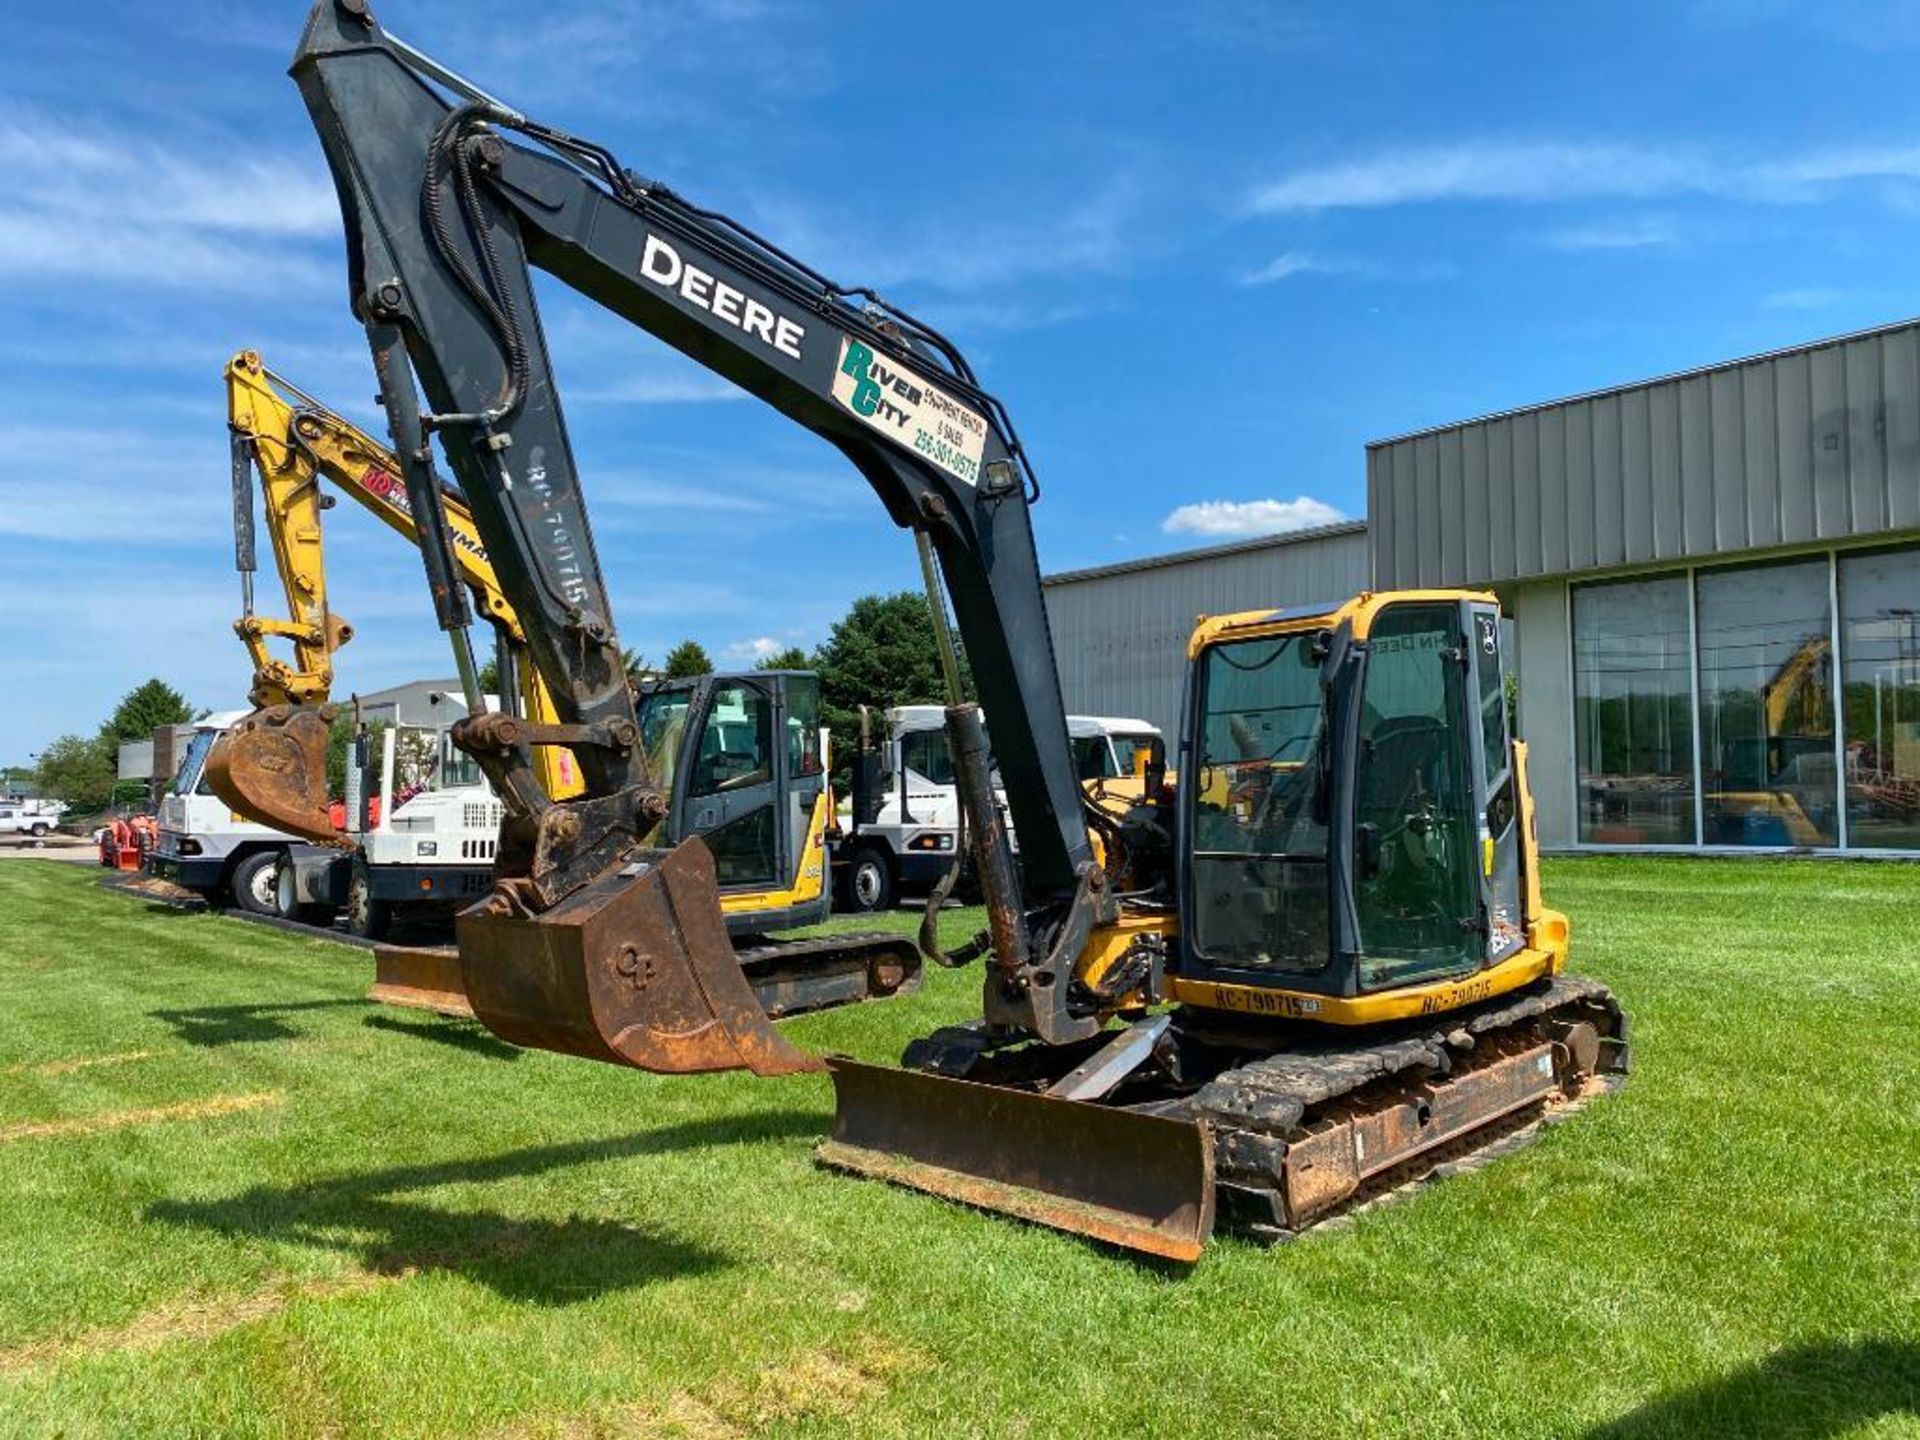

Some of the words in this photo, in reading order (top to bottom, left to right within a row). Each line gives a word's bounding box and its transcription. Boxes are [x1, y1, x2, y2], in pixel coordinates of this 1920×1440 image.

[640, 233, 804, 359] DEERE
[841, 339, 924, 407] RIVER
[851, 378, 912, 428] CITY
